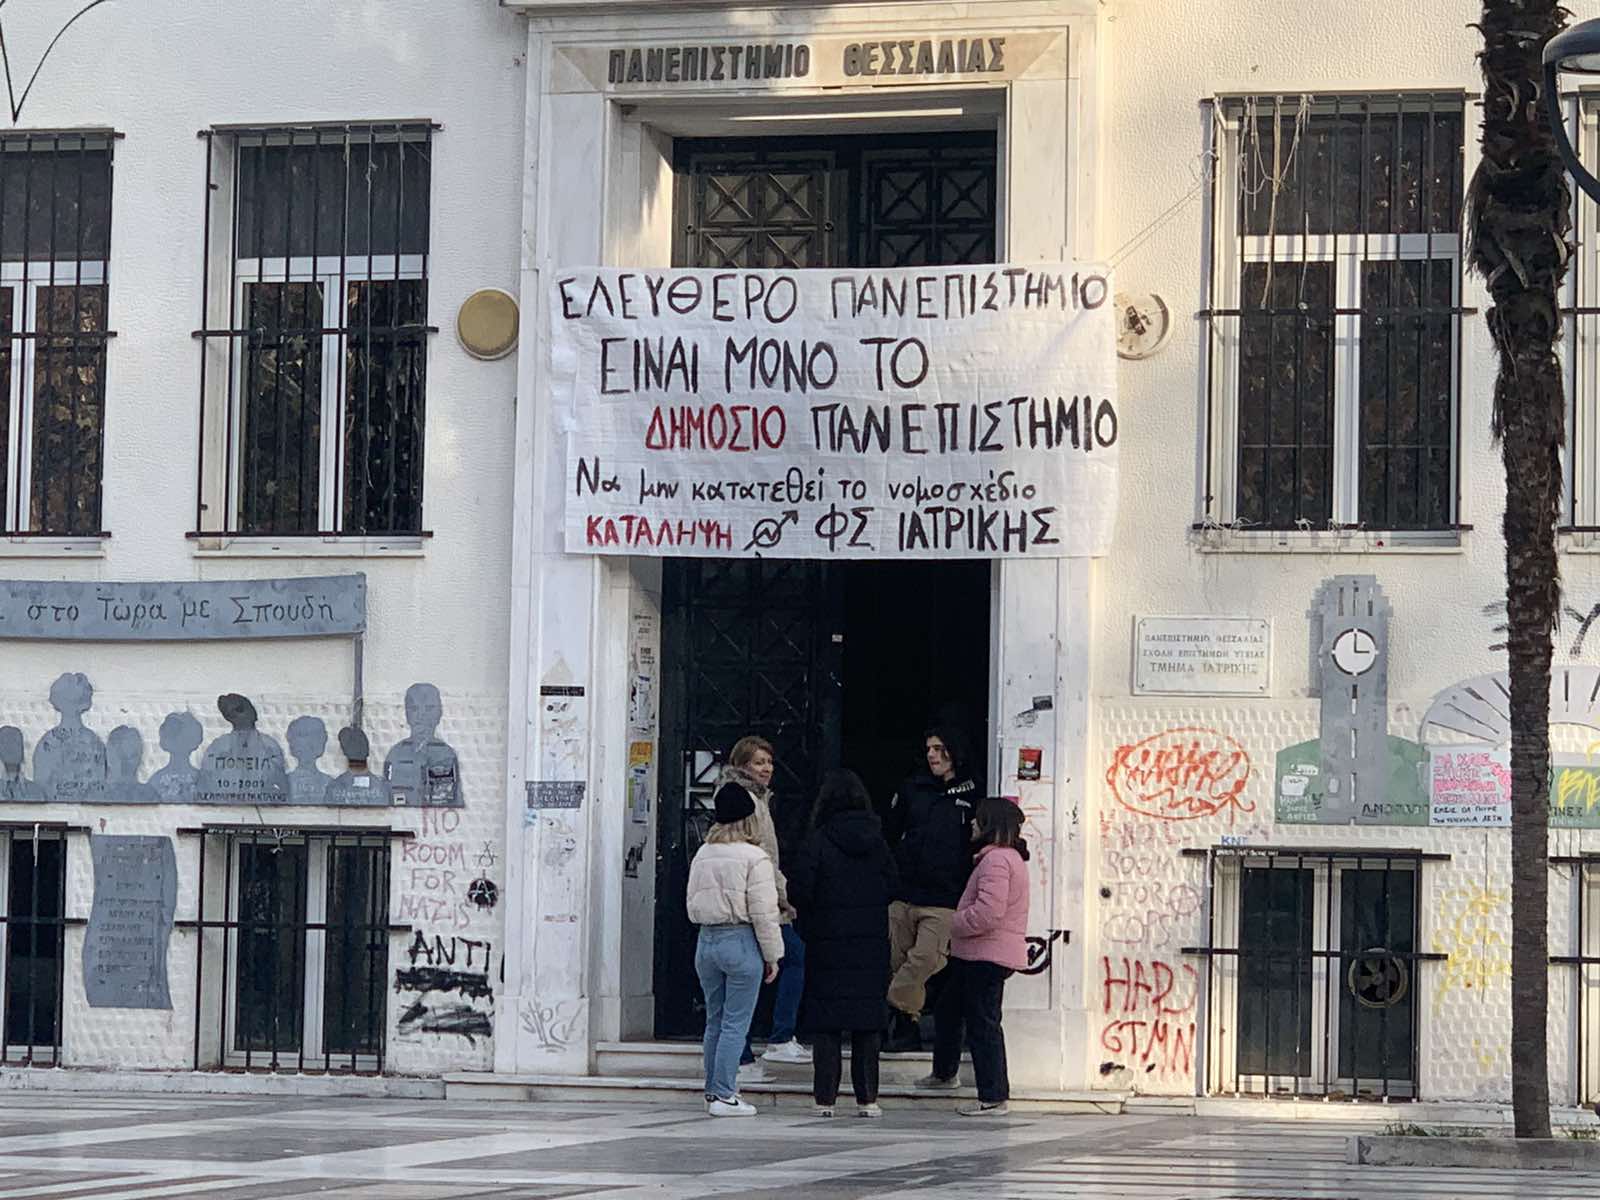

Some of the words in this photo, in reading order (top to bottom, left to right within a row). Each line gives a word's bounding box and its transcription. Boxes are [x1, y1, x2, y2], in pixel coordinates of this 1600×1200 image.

[608, 45, 810, 84] ΠΑΝΕΠΙΣΤΗΜΙΟ
[843, 38, 1006, 76] ΘΕΣΣΑΛΙΑΣ
[559, 273, 798, 323] ΕΛΕΥΘΕΡΟ
[831, 268, 1108, 320] ΠΑΝΕΠΙΣΤΗΜΙΟ
[601, 336, 698, 394] ΕΙΝΑΙ
[725, 336, 838, 393] ΜΟΝΟ
[860, 337, 929, 391] ΤΟ
[645, 403, 786, 452] ΔΗΜΟΣΙΟ
[811, 396, 1117, 453] ΠΑΝΕΠΙΣΤΗΜΙΟ
[577, 457, 621, 496] Να
[640, 468, 679, 505] μην
[692, 467, 824, 504] κατατεθεί
[838, 480, 866, 499] το
[889, 470, 1036, 505] νομοσχέδιο
[586, 515, 733, 550] ΚΑΤΑΛΗΨΗ
[900, 505, 1059, 552] ΙΑΤΡΙΚΗΣ
[27, 604, 79, 620] στο
[97, 597, 167, 628] Τώρα
[181, 599, 211, 627] με
[230, 595, 336, 624] Σπουδή
[1144, 634, 1211, 643] ΠΑΝΕΠΙΣΤΗΜΙΟ
[1150, 662, 1195, 673] ΤΜΗΜΑ
[402, 840, 467, 872] ROOM
[411, 867, 456, 895] FOR
[399, 894, 471, 928] NAZIS
[408, 930, 491, 973] ANTI
